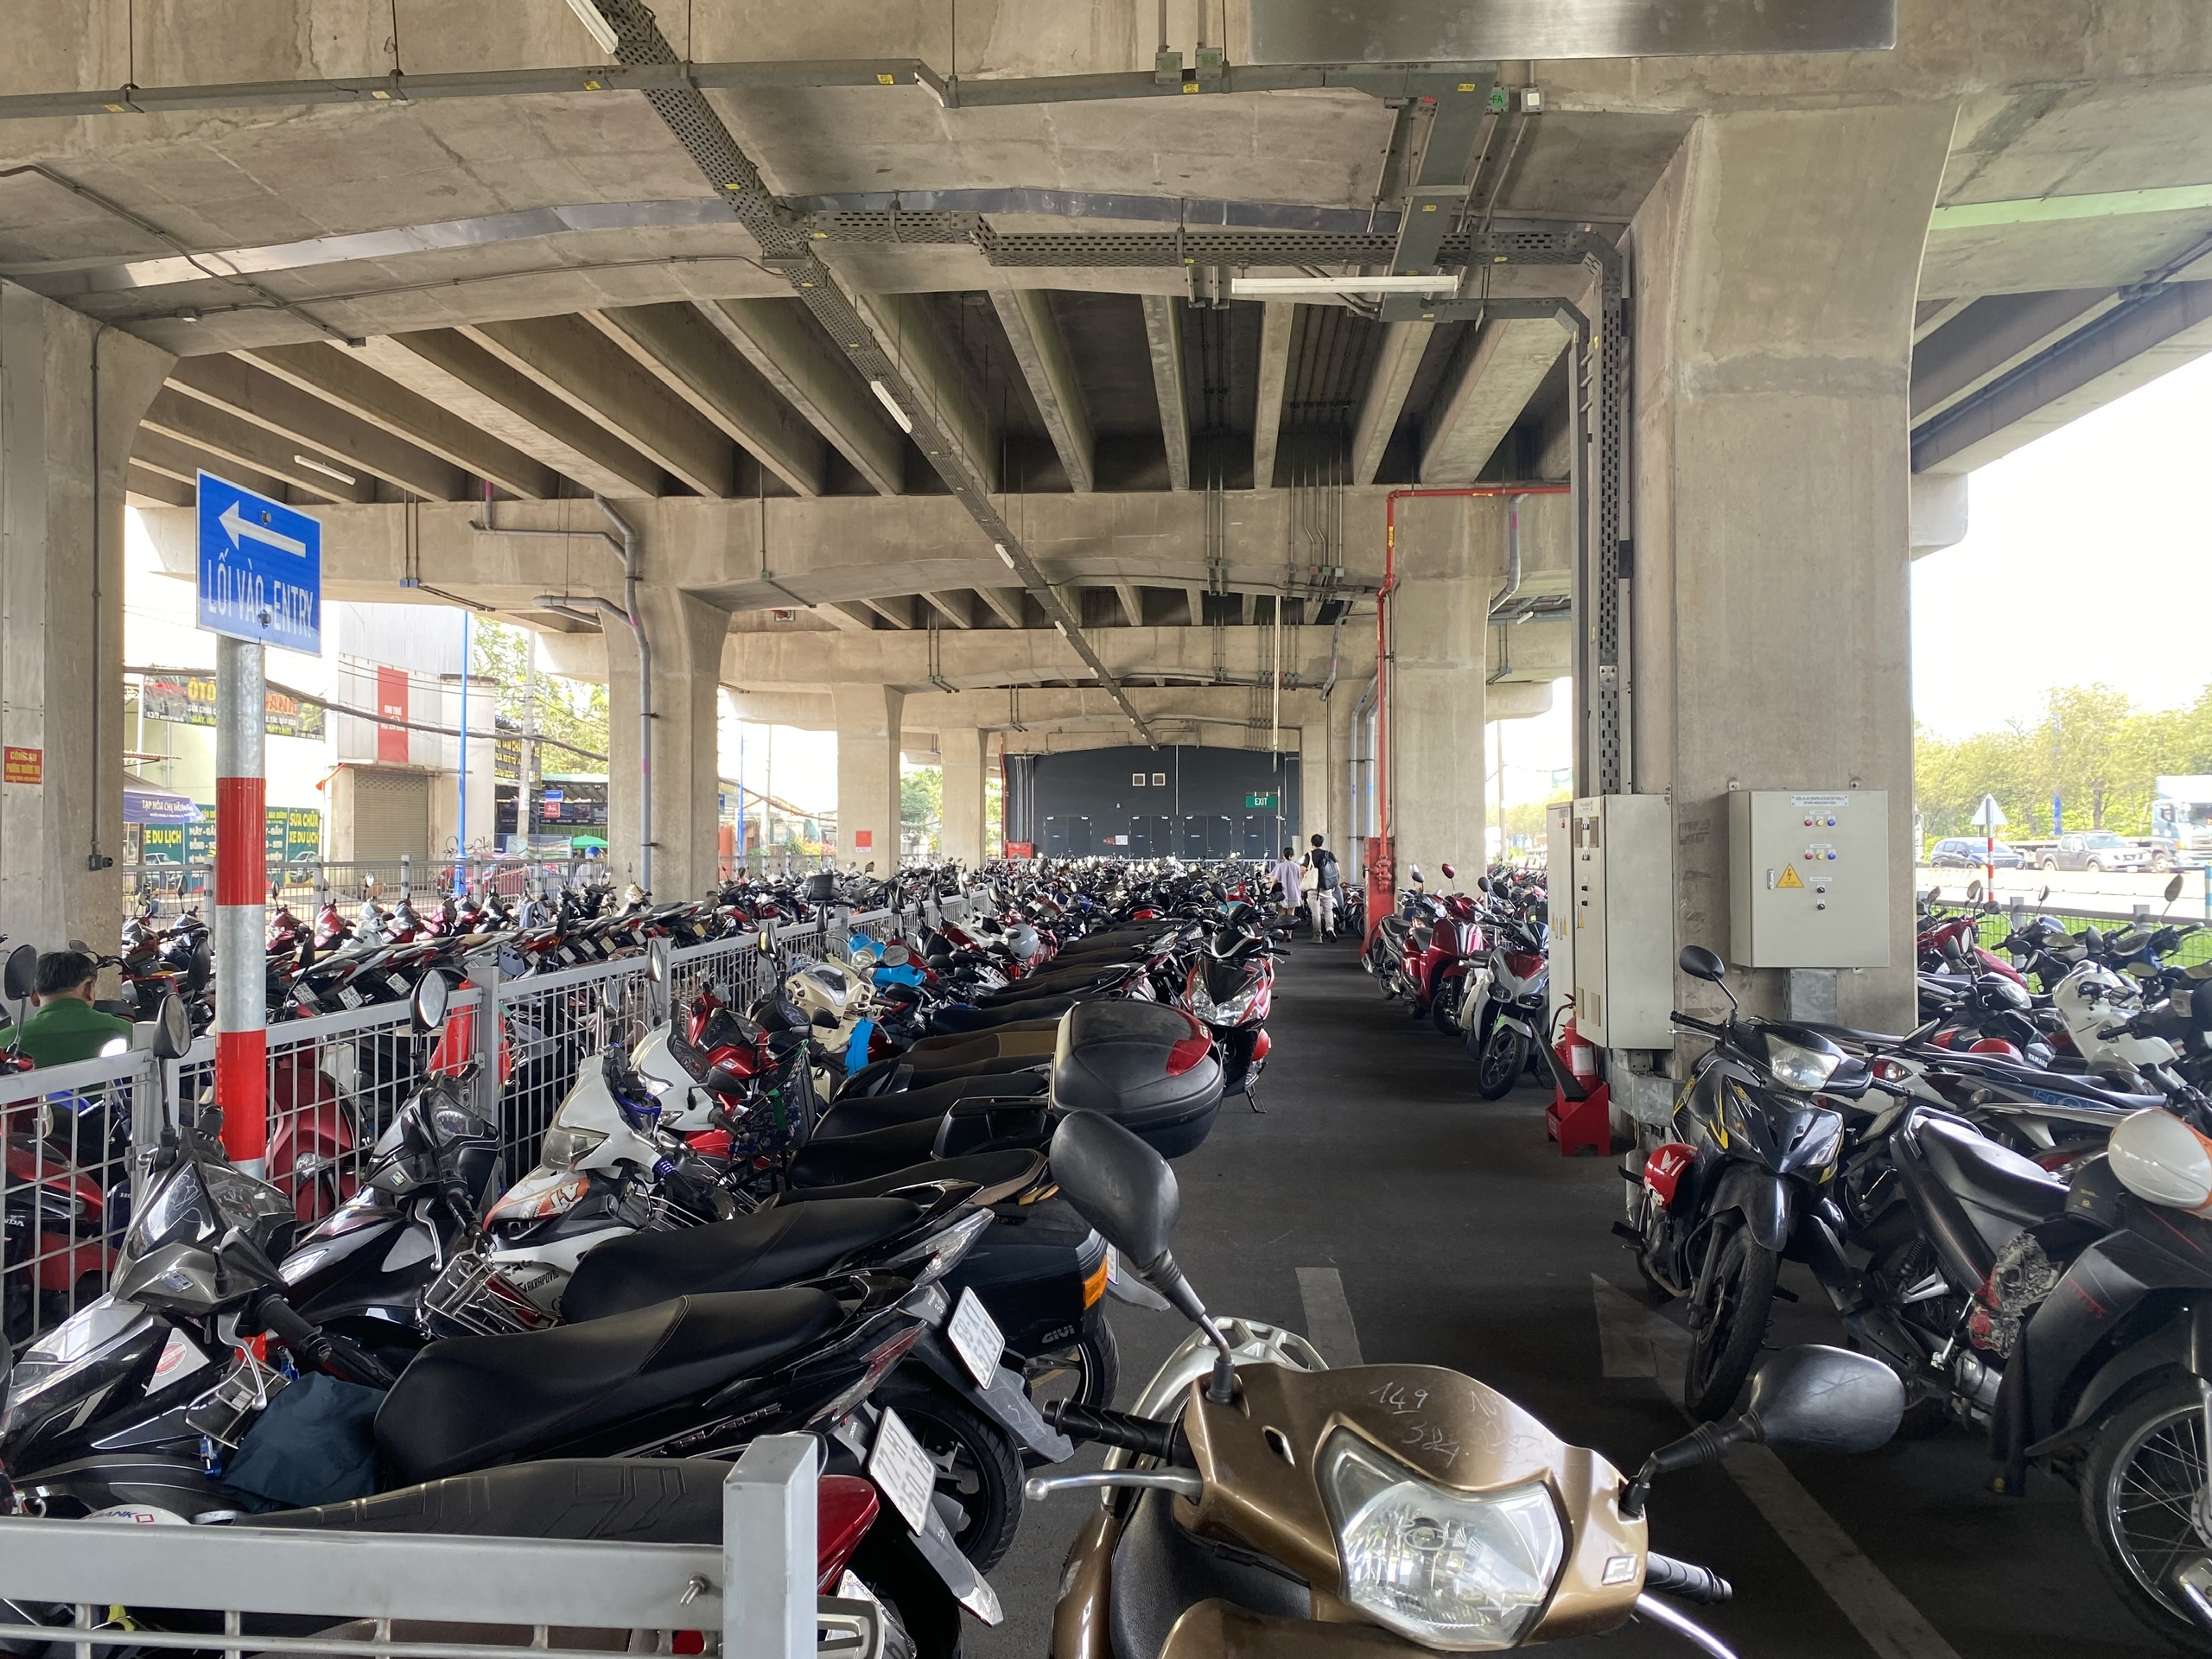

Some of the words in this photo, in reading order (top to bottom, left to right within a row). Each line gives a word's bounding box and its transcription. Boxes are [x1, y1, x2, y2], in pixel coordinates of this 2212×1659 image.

[1492, 95, 1503, 104] FA
[207, 547, 232, 618] LỐI
[188, 677, 217, 702] ÔTÔ
[1255, 797, 1268, 806] EXIT
[289, 809, 302, 827] SỬA
[302, 810, 319, 828] CHỮA
[152, 830, 163, 843] DU
[164, 830, 181, 848] LỊCH
[289, 830, 296, 843] XE
[297, 830, 306, 843] DU
[306, 831, 319, 848] LỊCH
[2028, 1052, 2048, 1069] YAMAHA
[1775, 1093, 1805, 1108] HONDA
[4, 1218, 25, 1228] NDA
[954, 1298, 982, 1349] 59-K1
[1041, 1324, 1076, 1344] GIVI
[875, 1421, 910, 1491] 77-H1
[898, 1445, 932, 1528] 350.18
[1606, 1558, 1636, 1575] FI
